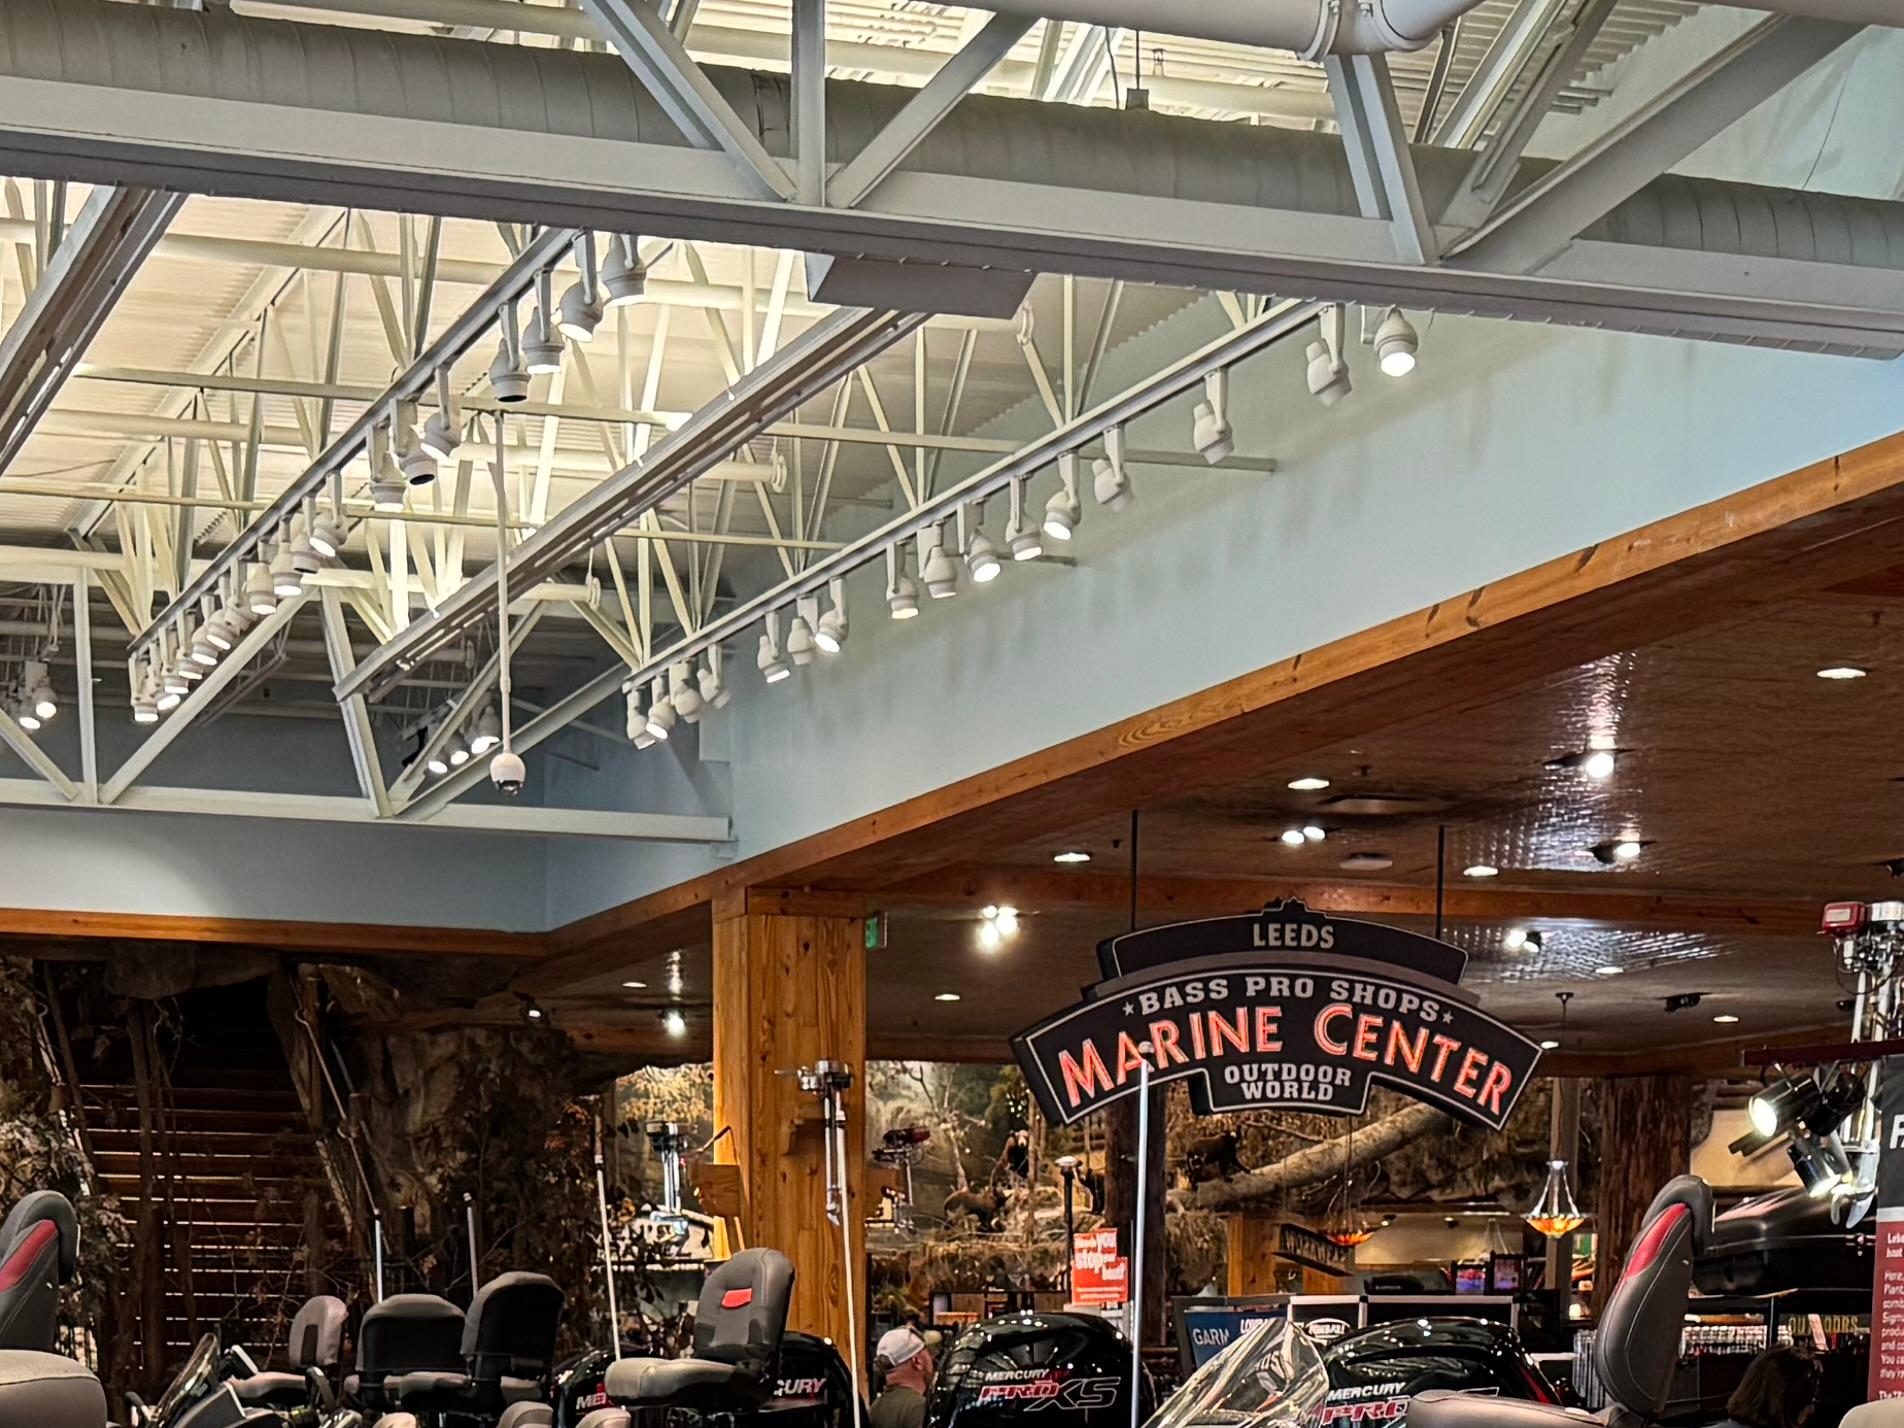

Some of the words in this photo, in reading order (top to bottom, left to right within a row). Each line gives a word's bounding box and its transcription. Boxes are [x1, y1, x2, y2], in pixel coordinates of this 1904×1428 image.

[1252, 923, 1335, 950] LEEDS
[1138, 977, 1230, 1016] BASS
[1244, 975, 1315, 999] PRO
[1329, 979, 1440, 1024] SHOPS
[1057, 1005, 1284, 1110] MARINE
[1313, 1002, 1514, 1117] CENTER
[1223, 1062, 1352, 1088] OUTDOOR
[1239, 1080, 1335, 1102] WORLD
[984, 1368, 1050, 1383] MERCURY
[1327, 1382, 1407, 1401] MERCURY
